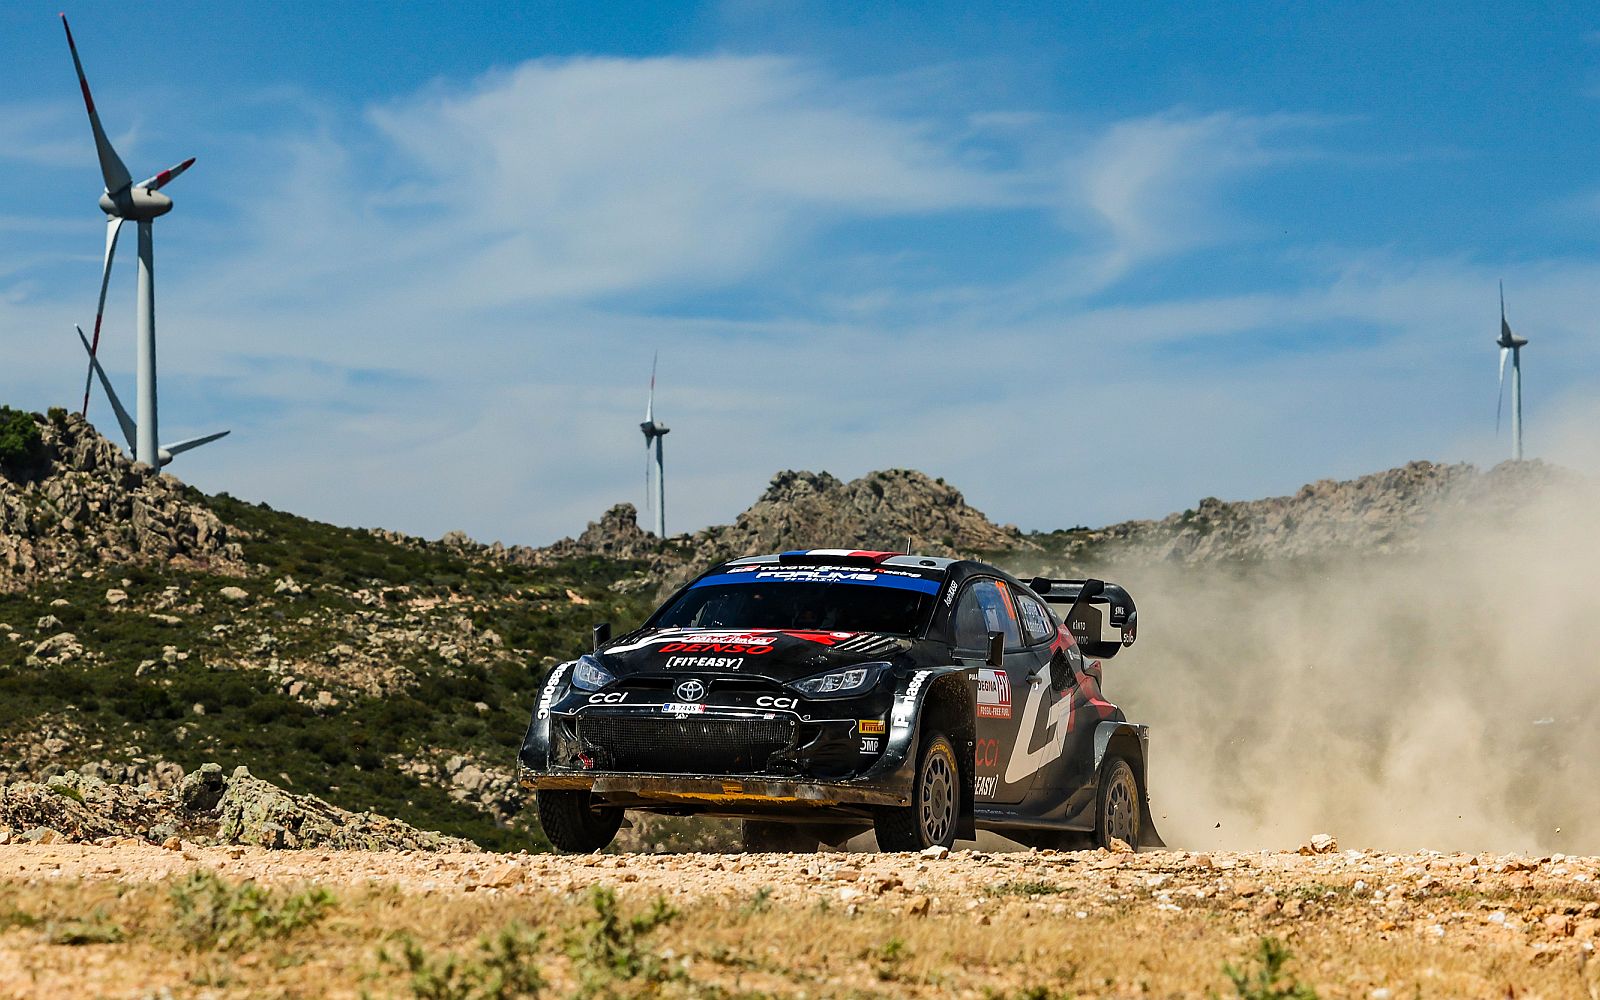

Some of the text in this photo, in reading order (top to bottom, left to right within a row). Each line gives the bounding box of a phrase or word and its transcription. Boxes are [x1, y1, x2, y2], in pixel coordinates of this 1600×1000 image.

[755, 571, 878, 581] FORUM8
[658, 643, 774, 655] DENSO
[978, 680, 997, 692] DEGNA
[589, 692, 629, 704] CCI
[756, 696, 799, 709] CCI
[862, 722, 884, 732] PIRELLI
[975, 737, 999, 767] CCI
